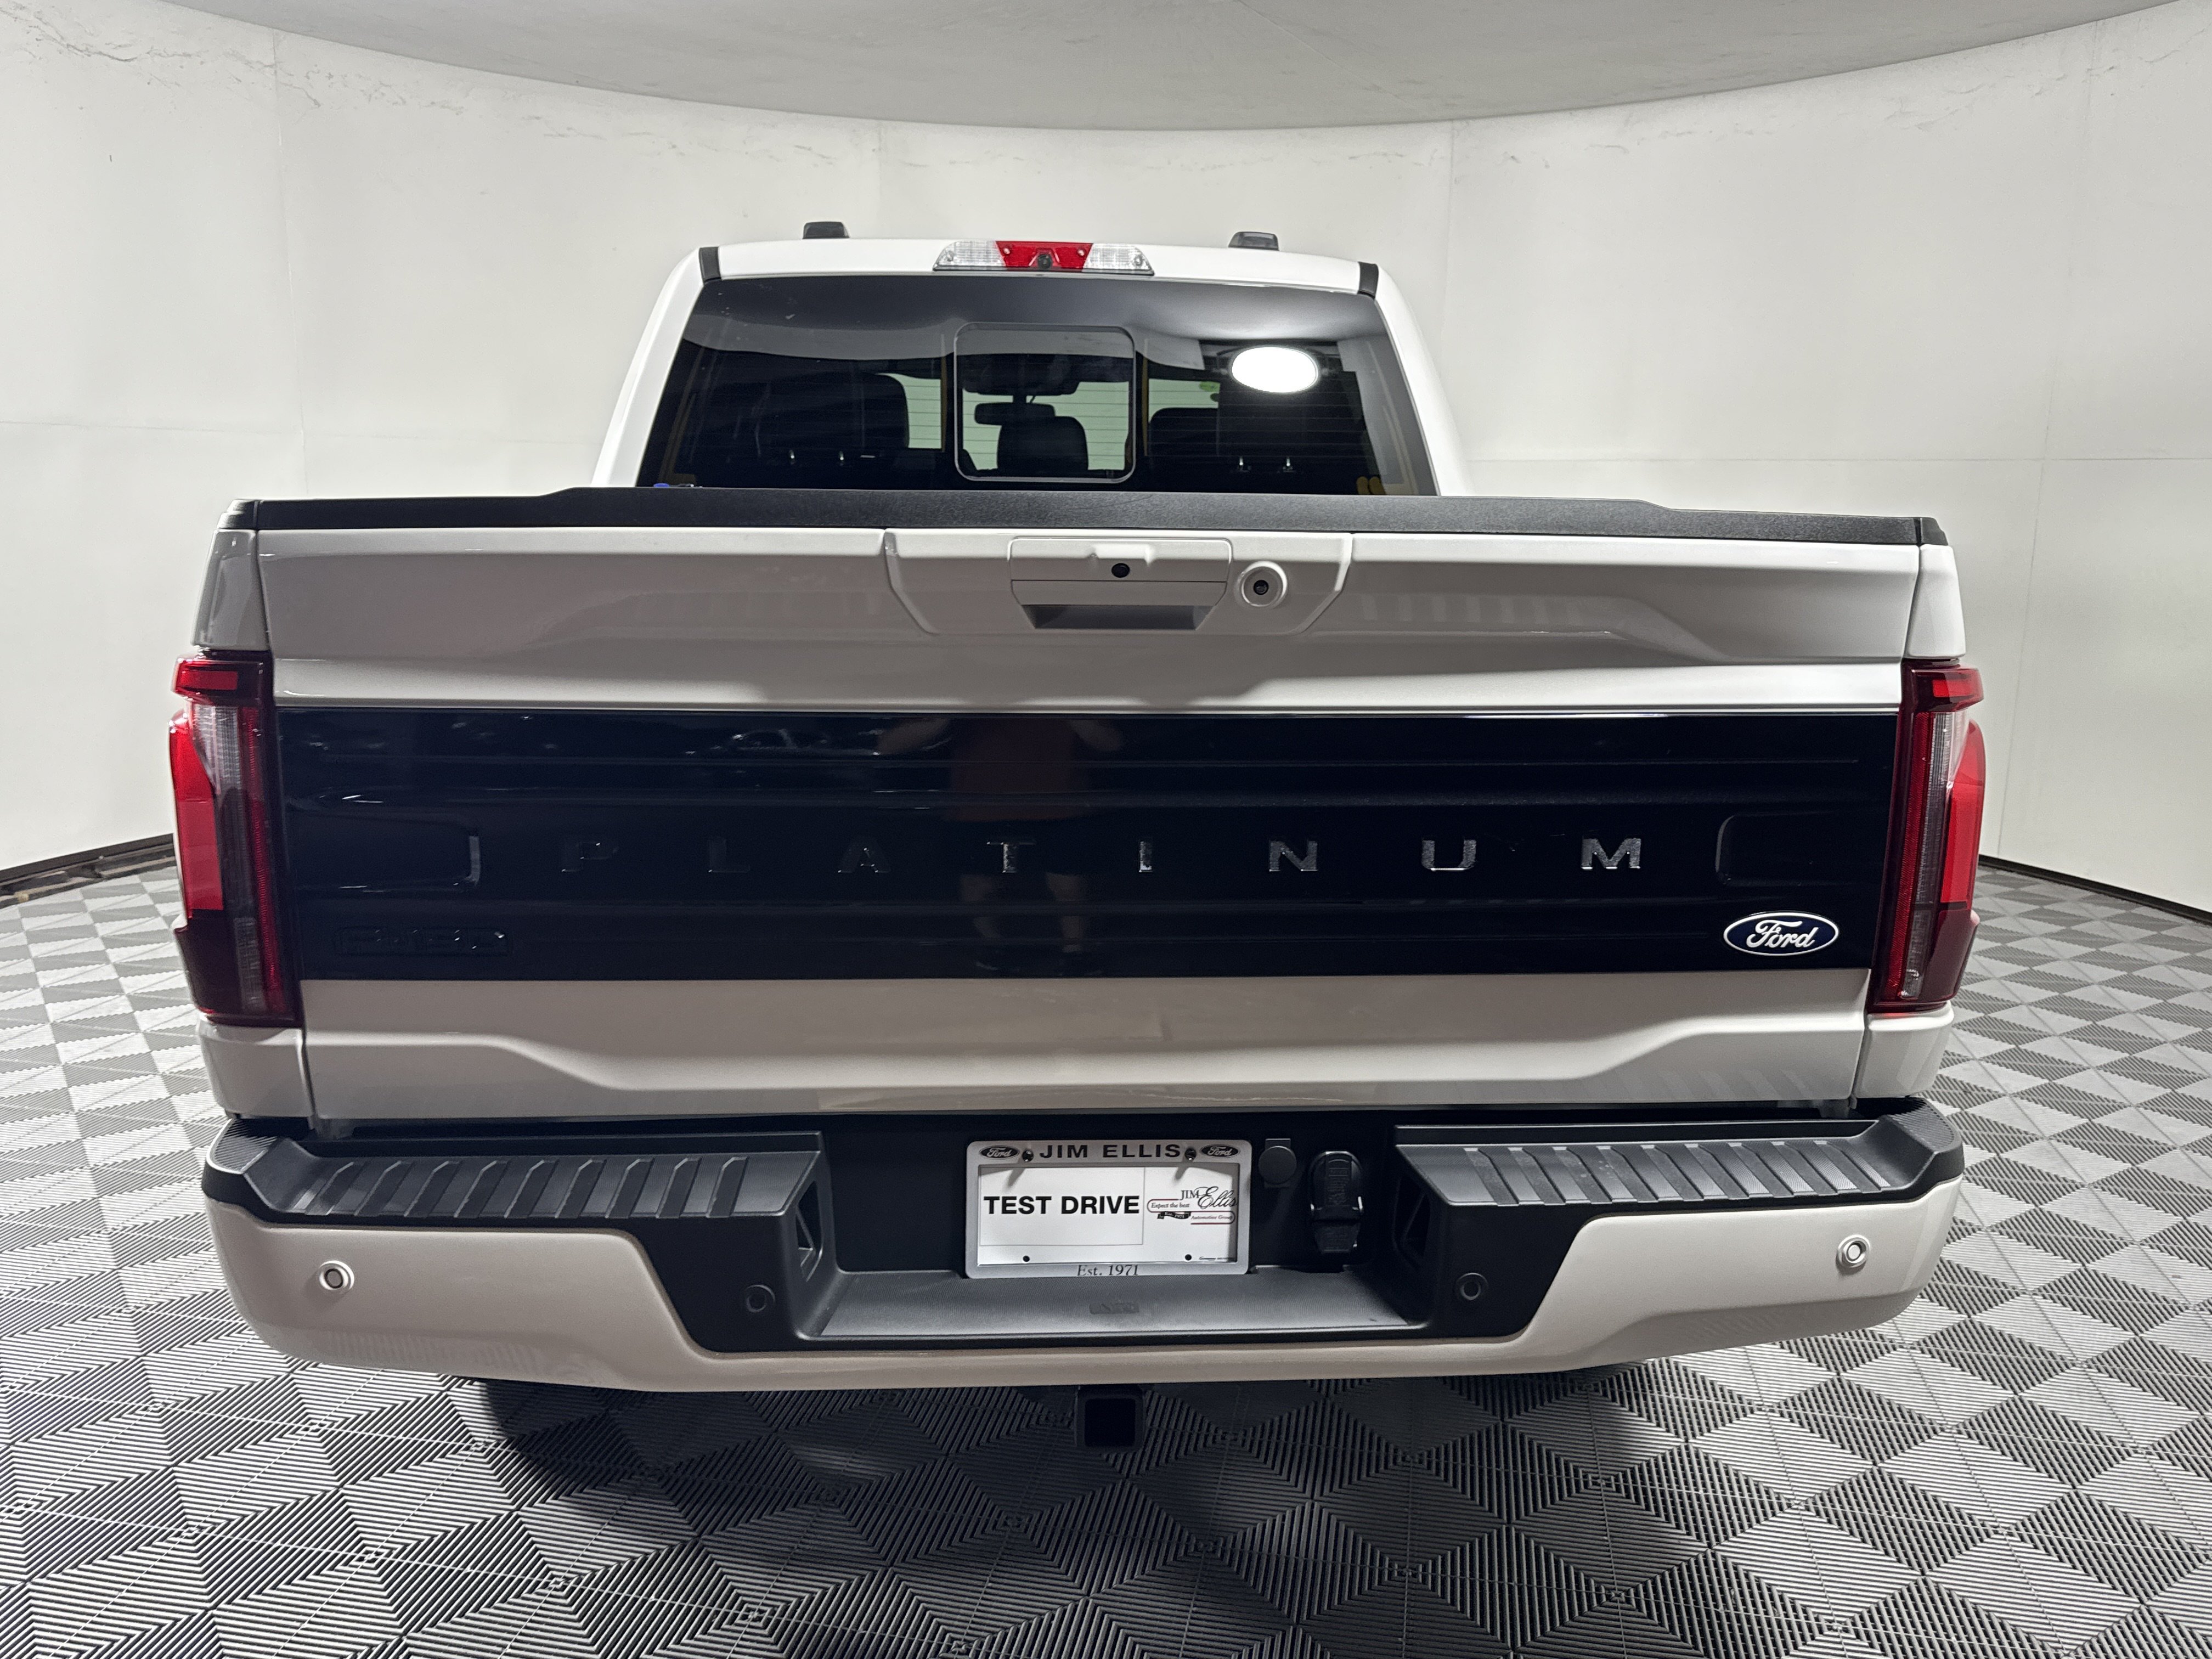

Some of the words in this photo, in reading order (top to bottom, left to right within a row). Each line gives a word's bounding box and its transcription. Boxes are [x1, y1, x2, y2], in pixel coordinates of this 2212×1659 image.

[560, 836, 1641, 873] PLATINUM
[1746, 919, 1819, 949] Ford
[1040, 1144, 1088, 1159] JIM
[1102, 1144, 1181, 1158] ELLIS
[984, 1195, 1052, 1215] TEST
[1061, 1195, 1140, 1215] DRIVE
[1179, 1189, 1200, 1200] JIM
[1194, 1186, 1238, 1210] Ellis
[1077, 1264, 1102, 1276] Est.
[1108, 1264, 1139, 1276] 1971
